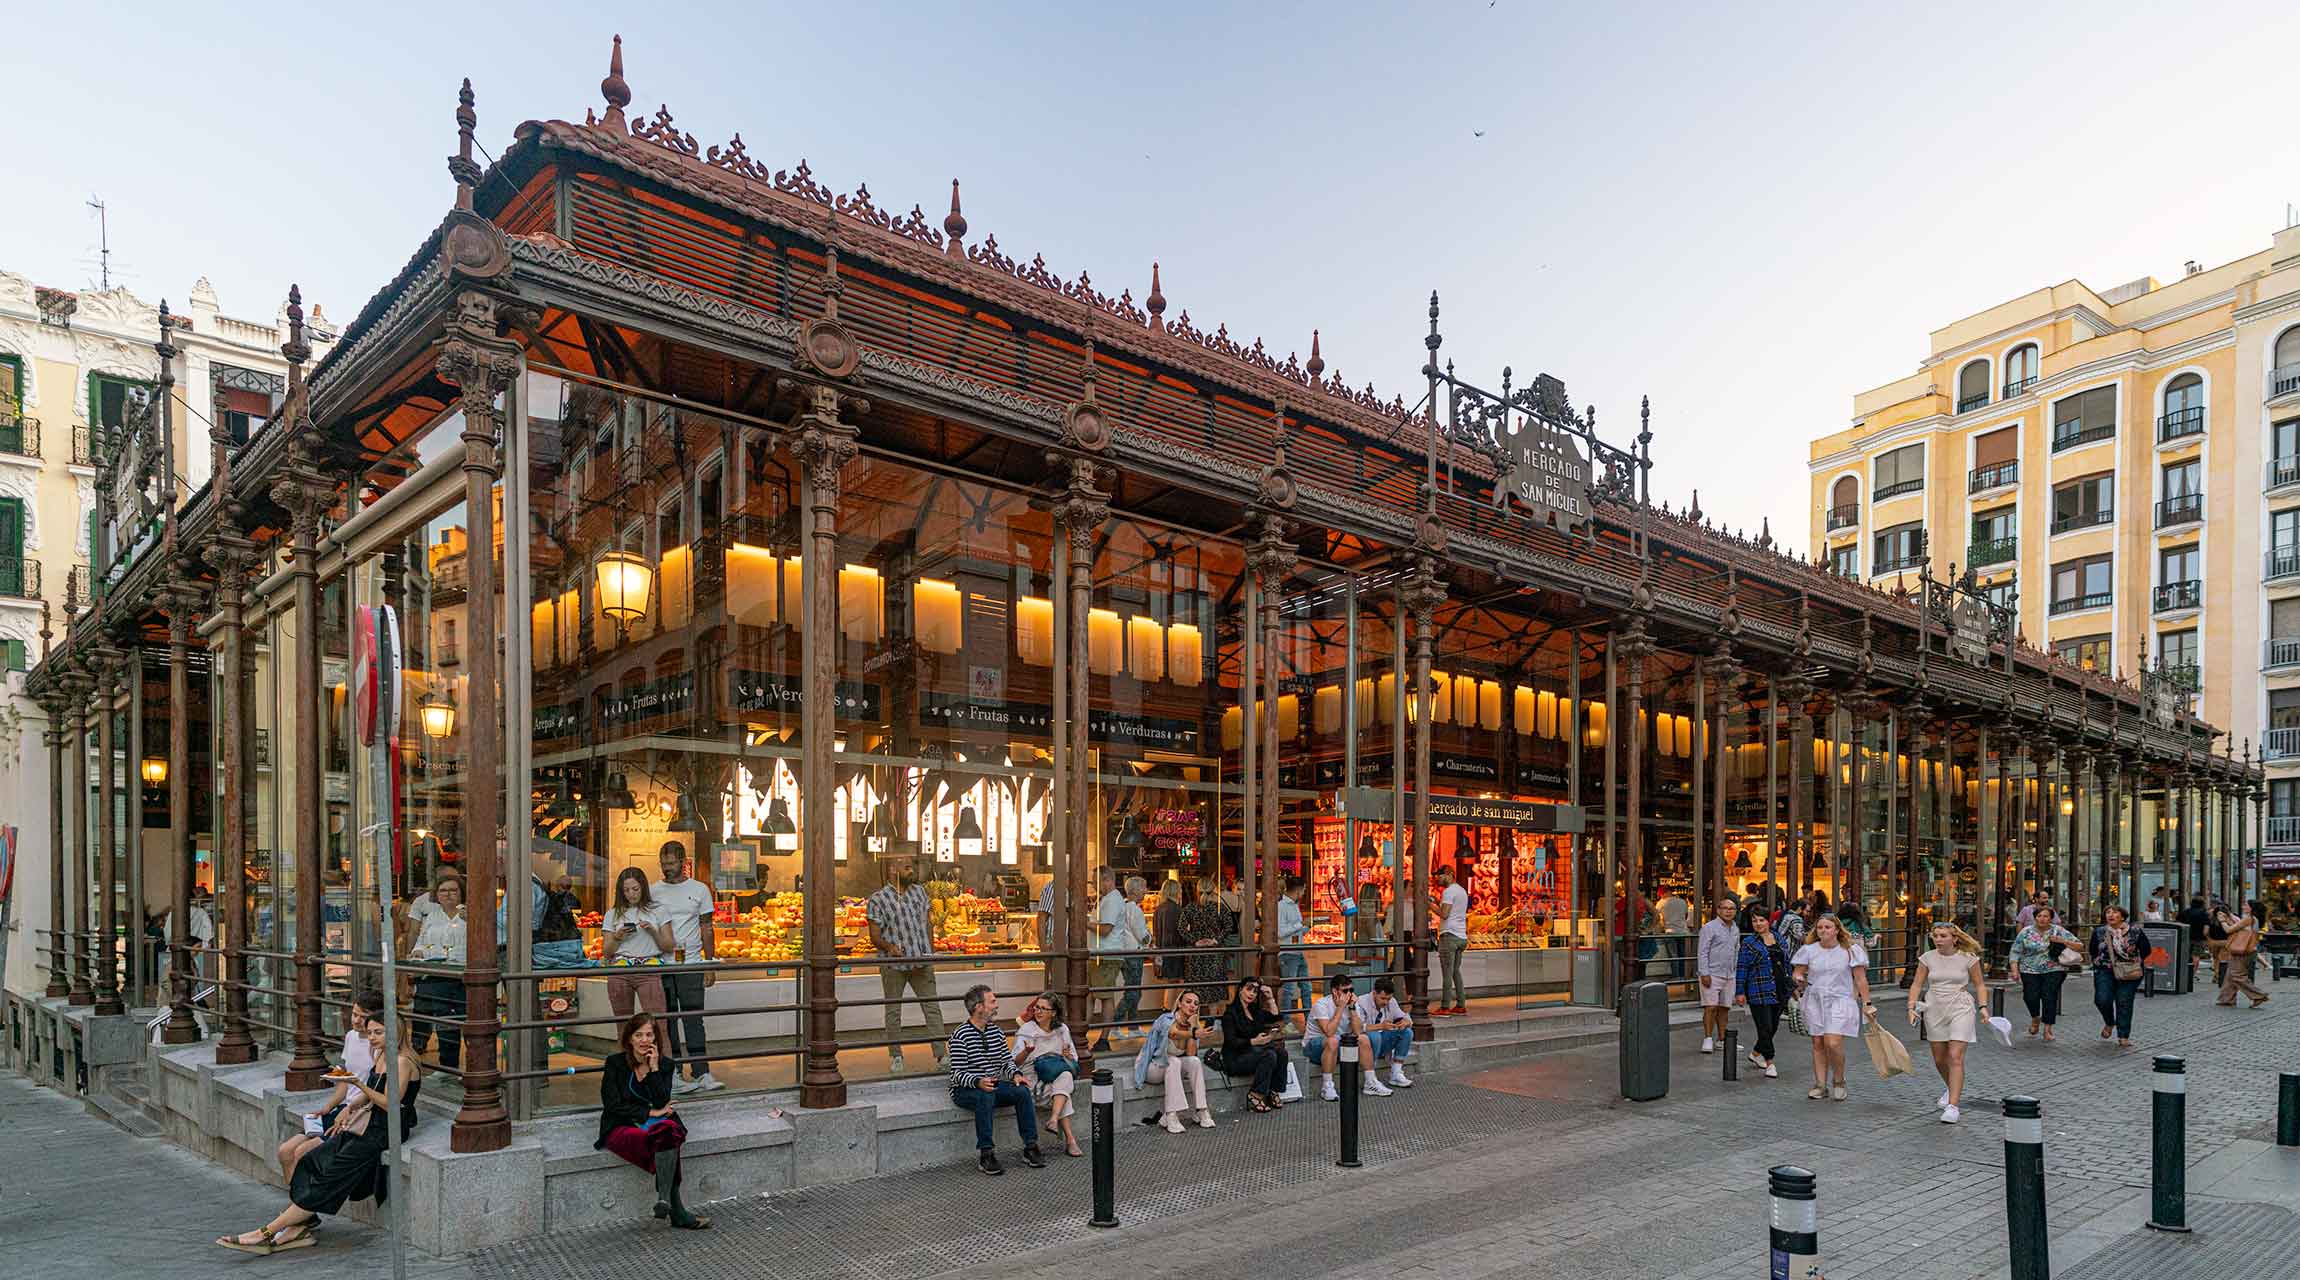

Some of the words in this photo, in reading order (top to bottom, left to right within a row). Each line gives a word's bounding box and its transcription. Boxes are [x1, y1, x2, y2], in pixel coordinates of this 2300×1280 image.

[1523, 447, 1580, 481] MERCADO
[1521, 481, 1543, 503] SAN
[1545, 475, 1560, 489] DE
[632, 693, 658, 711] Frutas
[769, 683, 841, 706] Vers
[968, 705, 1009, 723] Frutas
[1119, 721, 1167, 739] Verduras
[1471, 801, 1482, 817] de
[1484, 807, 1501, 818] san
[1503, 806, 1534, 824] miguel
